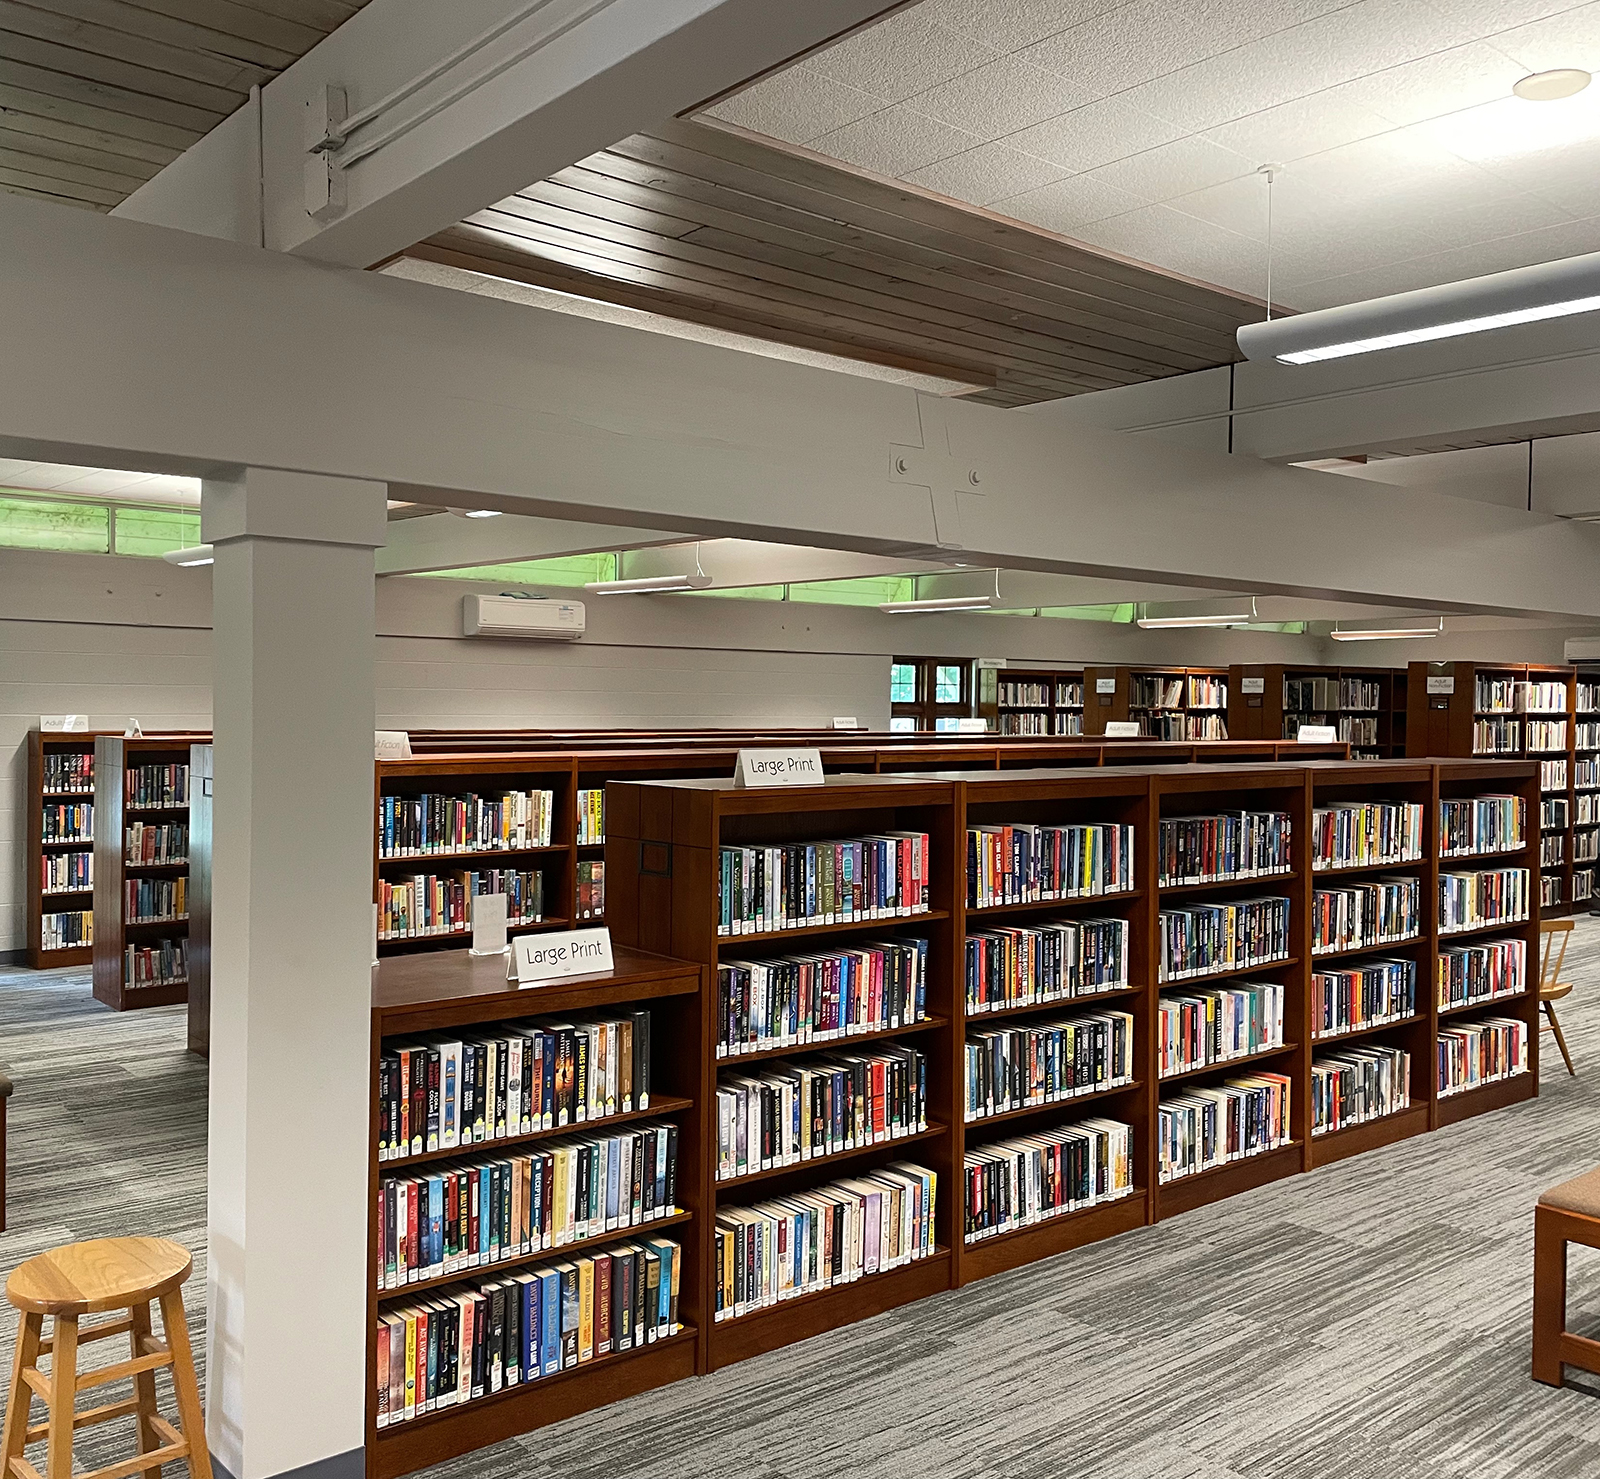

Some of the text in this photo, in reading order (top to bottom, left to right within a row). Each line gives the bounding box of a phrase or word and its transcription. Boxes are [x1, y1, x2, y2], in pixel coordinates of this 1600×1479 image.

[750, 756, 815, 776] Large Print
[526, 940, 603, 966] Large Print
[529, 1307, 537, 1340] BALDACCI
[548, 1277, 557, 1344] DAVID BALDACCI
